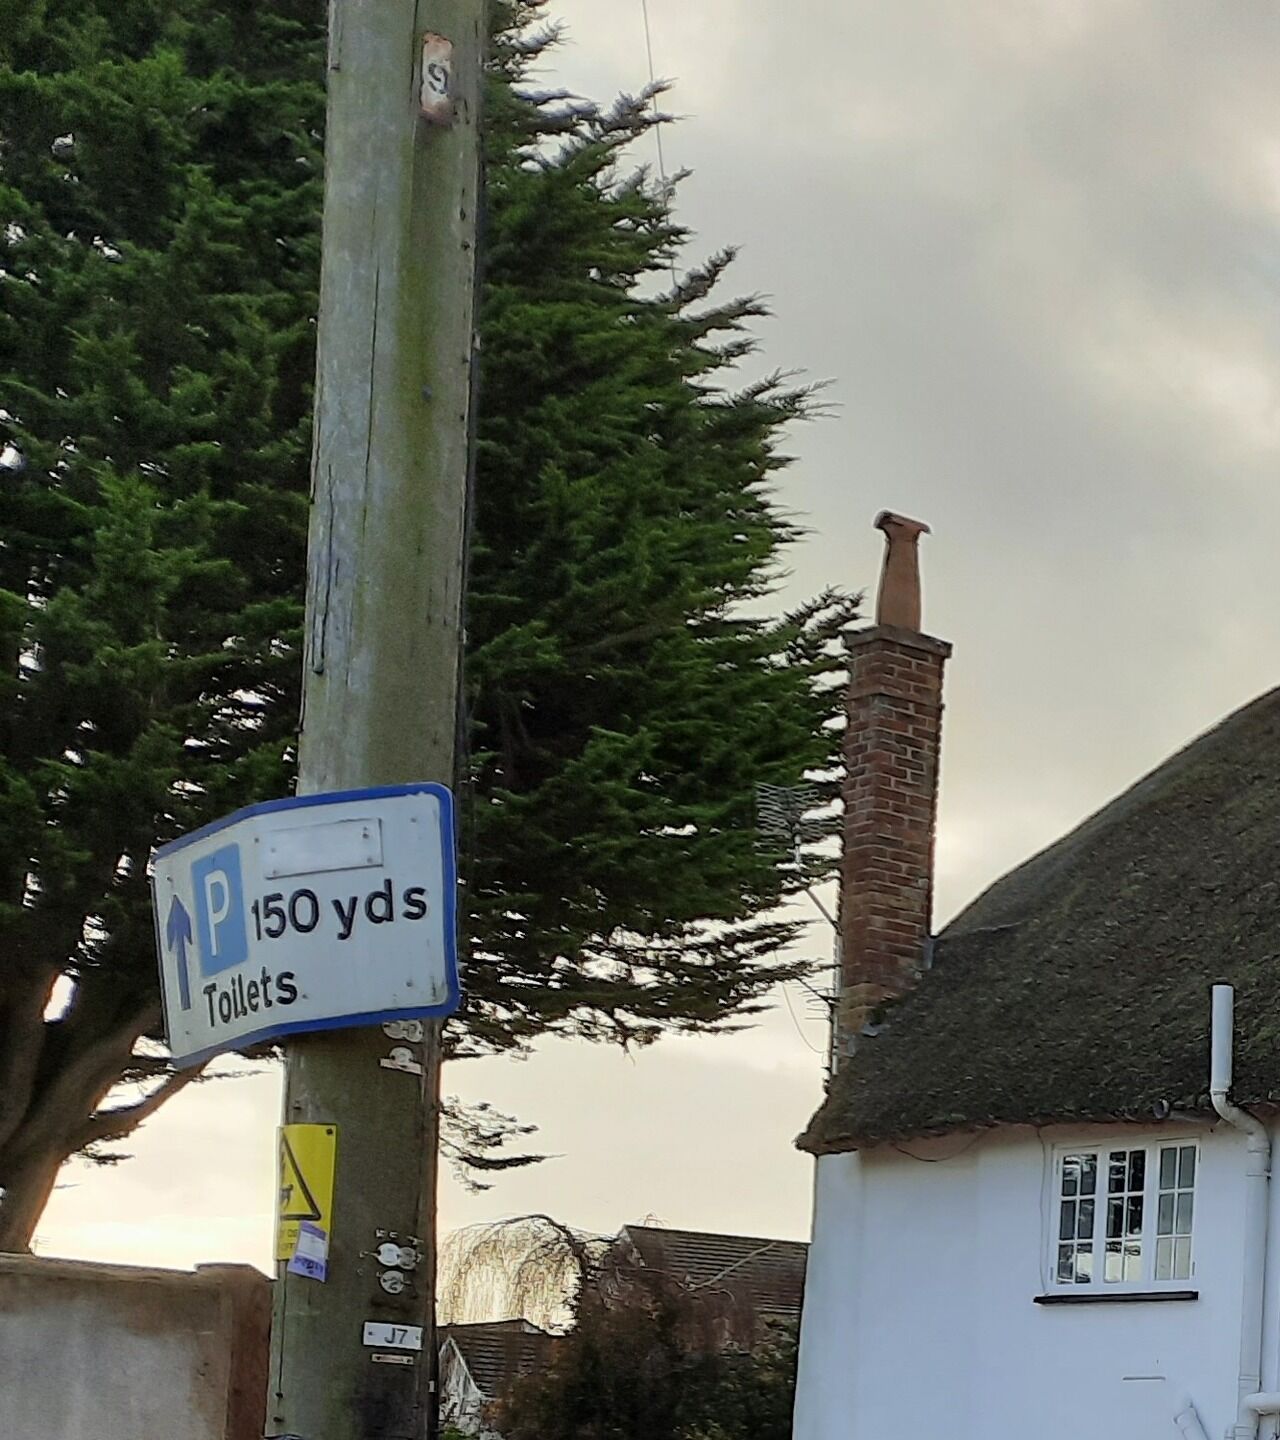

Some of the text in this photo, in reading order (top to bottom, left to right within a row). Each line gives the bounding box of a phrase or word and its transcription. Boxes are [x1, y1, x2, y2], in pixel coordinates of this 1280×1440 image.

[251, 888, 320, 941] 150
[331, 879, 428, 941] yds
[203, 967, 298, 1027] Toilets
[384, 1327, 408, 1344] J7
